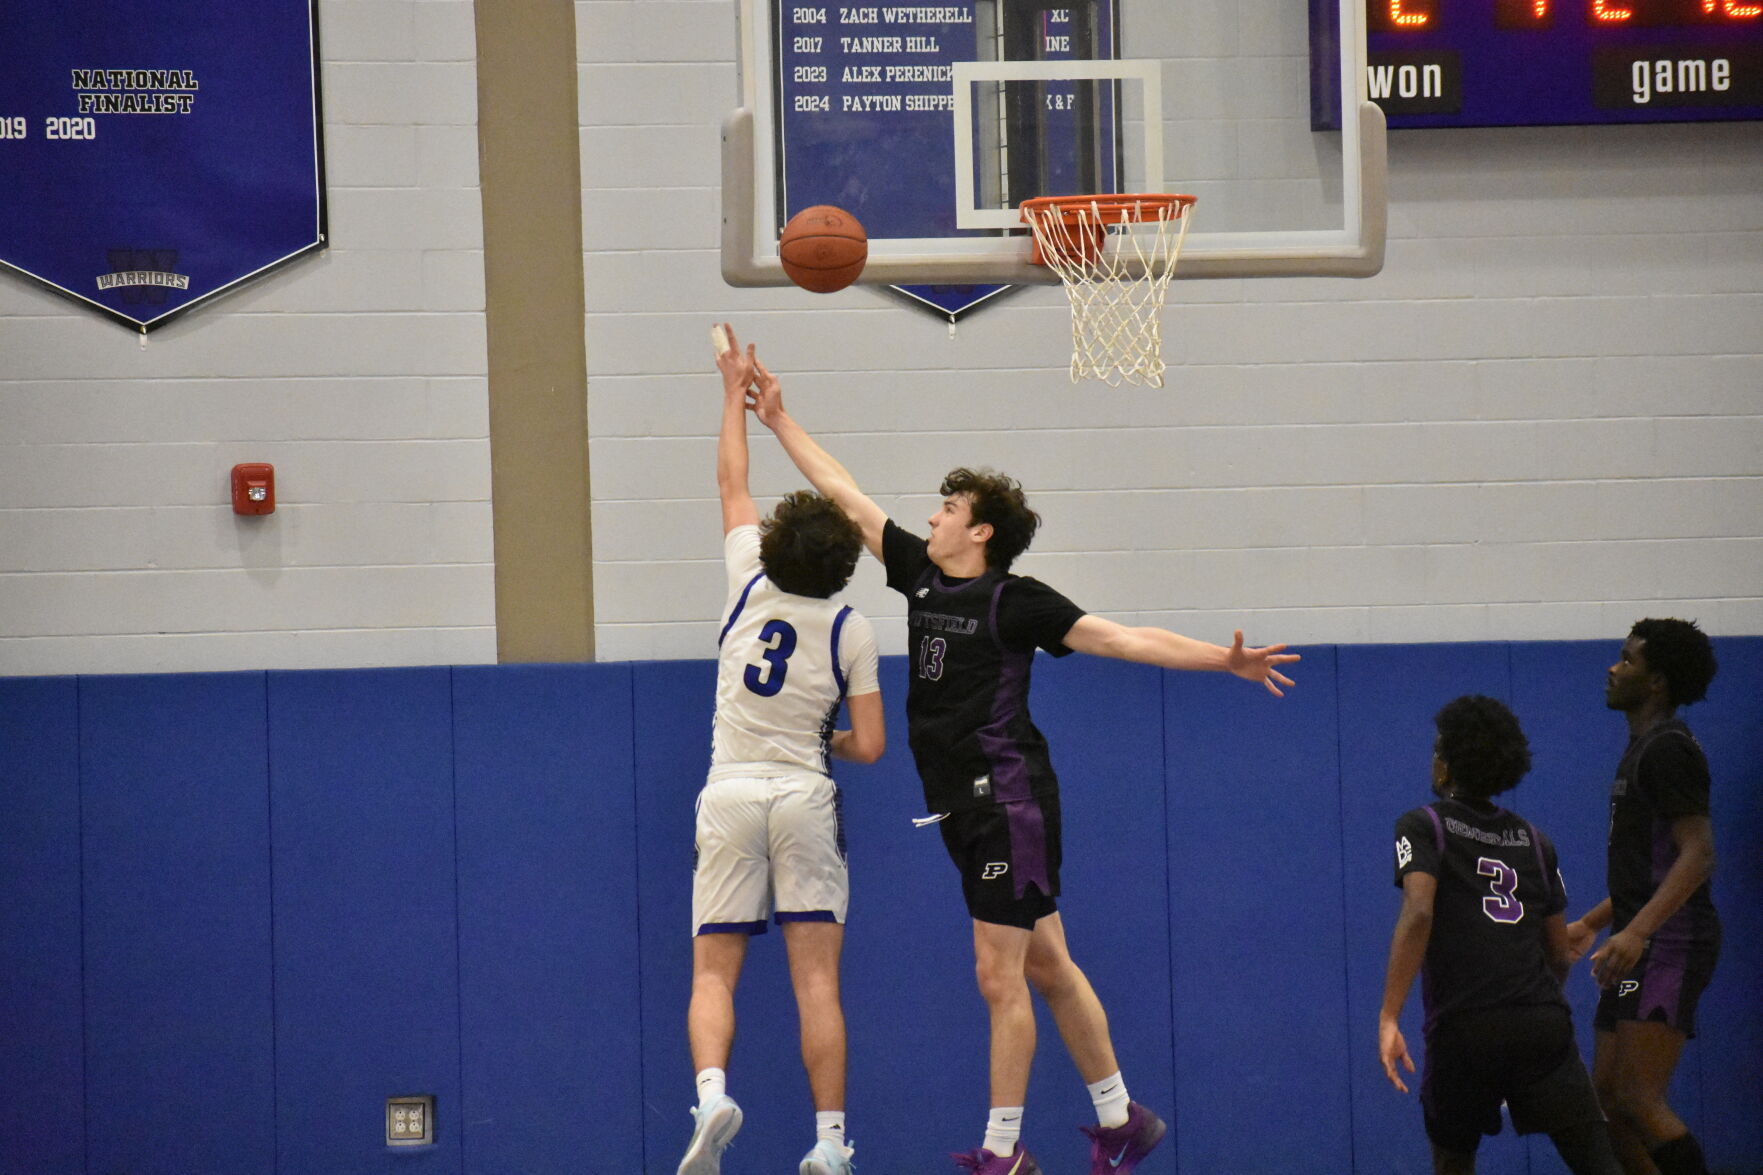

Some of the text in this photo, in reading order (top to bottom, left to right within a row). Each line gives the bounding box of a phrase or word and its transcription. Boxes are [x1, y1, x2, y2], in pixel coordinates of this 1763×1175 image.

[793, 7, 972, 23] 2004 ZACH WETHERELL
[794, 37, 940, 53] 2017 TANNER HILL
[71, 69, 199, 90] NATIONAL
[794, 66, 827, 82] 2023
[842, 66, 882, 82] ALEX
[1367, 64, 1442, 98] won
[1632, 59, 1731, 103] game
[78, 93, 194, 114] FINALIST
[794, 96, 830, 112] 2024
[842, 96, 902, 111] PAYTON
[45, 117, 96, 140] 2020
[99, 271, 188, 289] WARRIORS
[743, 618, 798, 698] 3
[918, 635, 947, 682] 13
[982, 862, 1008, 880] P
[1477, 856, 1524, 925] 3
[1618, 980, 1639, 997] P
